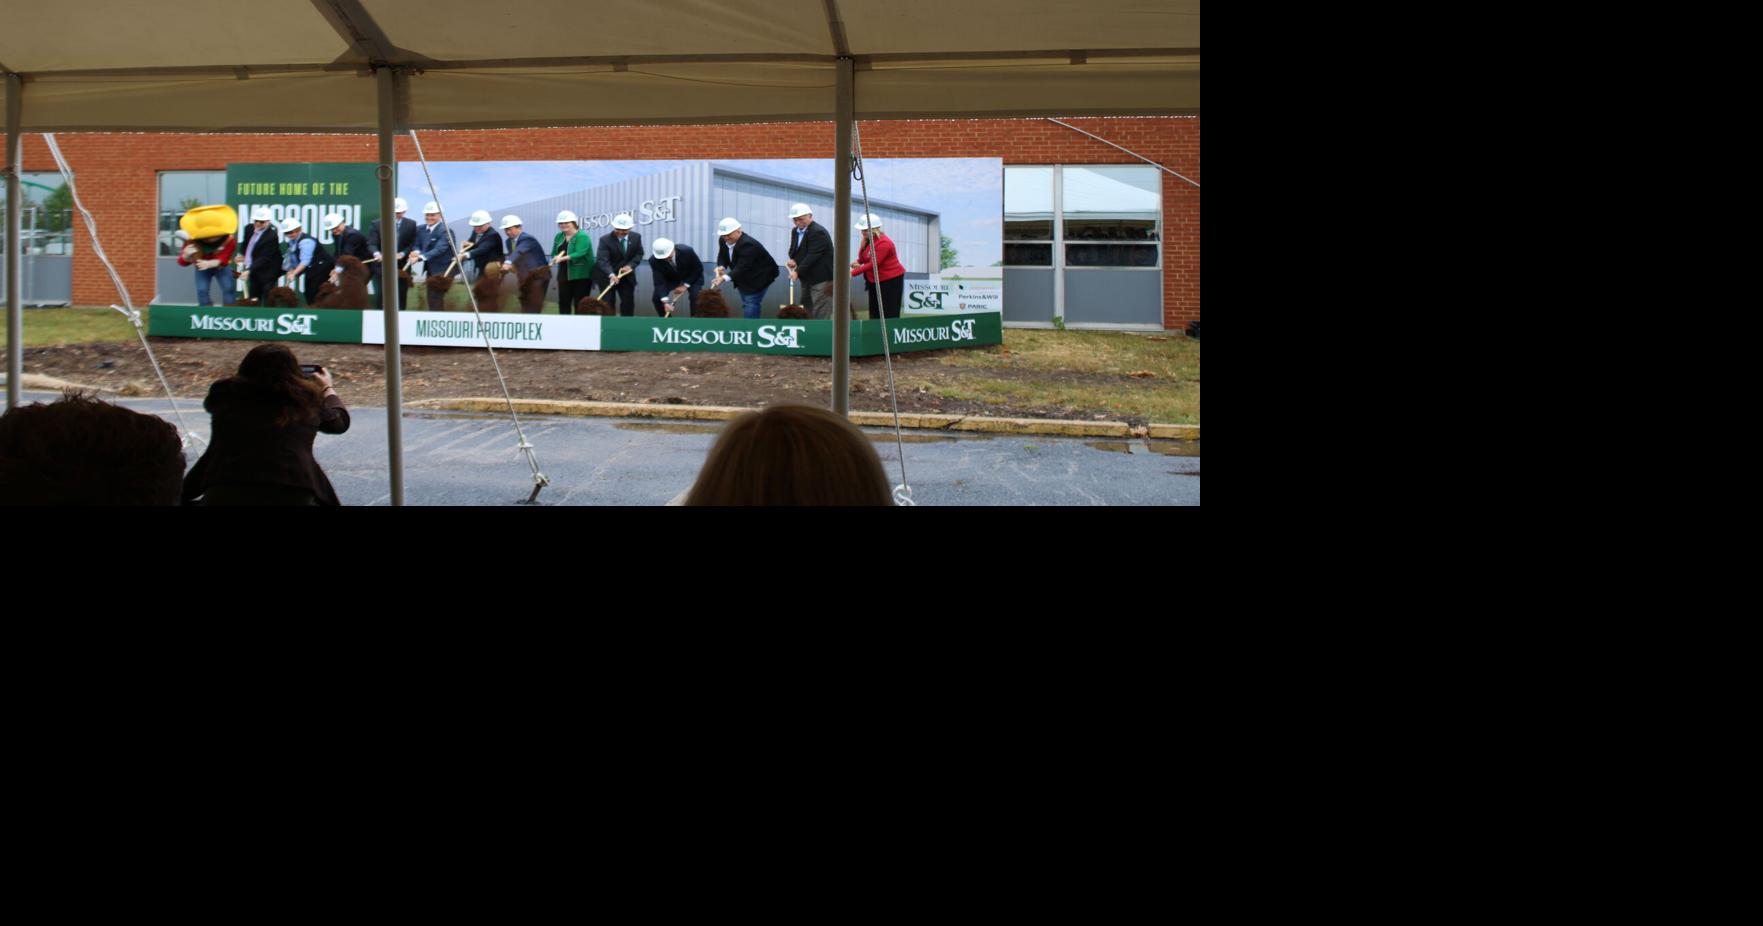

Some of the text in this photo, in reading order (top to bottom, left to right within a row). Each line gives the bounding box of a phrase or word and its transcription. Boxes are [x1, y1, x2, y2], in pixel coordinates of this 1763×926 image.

[237, 183, 348, 196] FUTURE HOME OF THE
[640, 196, 682, 225] S&T
[908, 291, 949, 310] S&T
[190, 313, 318, 335] MISSOURI S&T
[416, 319, 543, 341] MISSOURI PROTOPLEX
[893, 319, 976, 344] MISSOURI S&T
[652, 325, 805, 349] MISSOURI S&T
